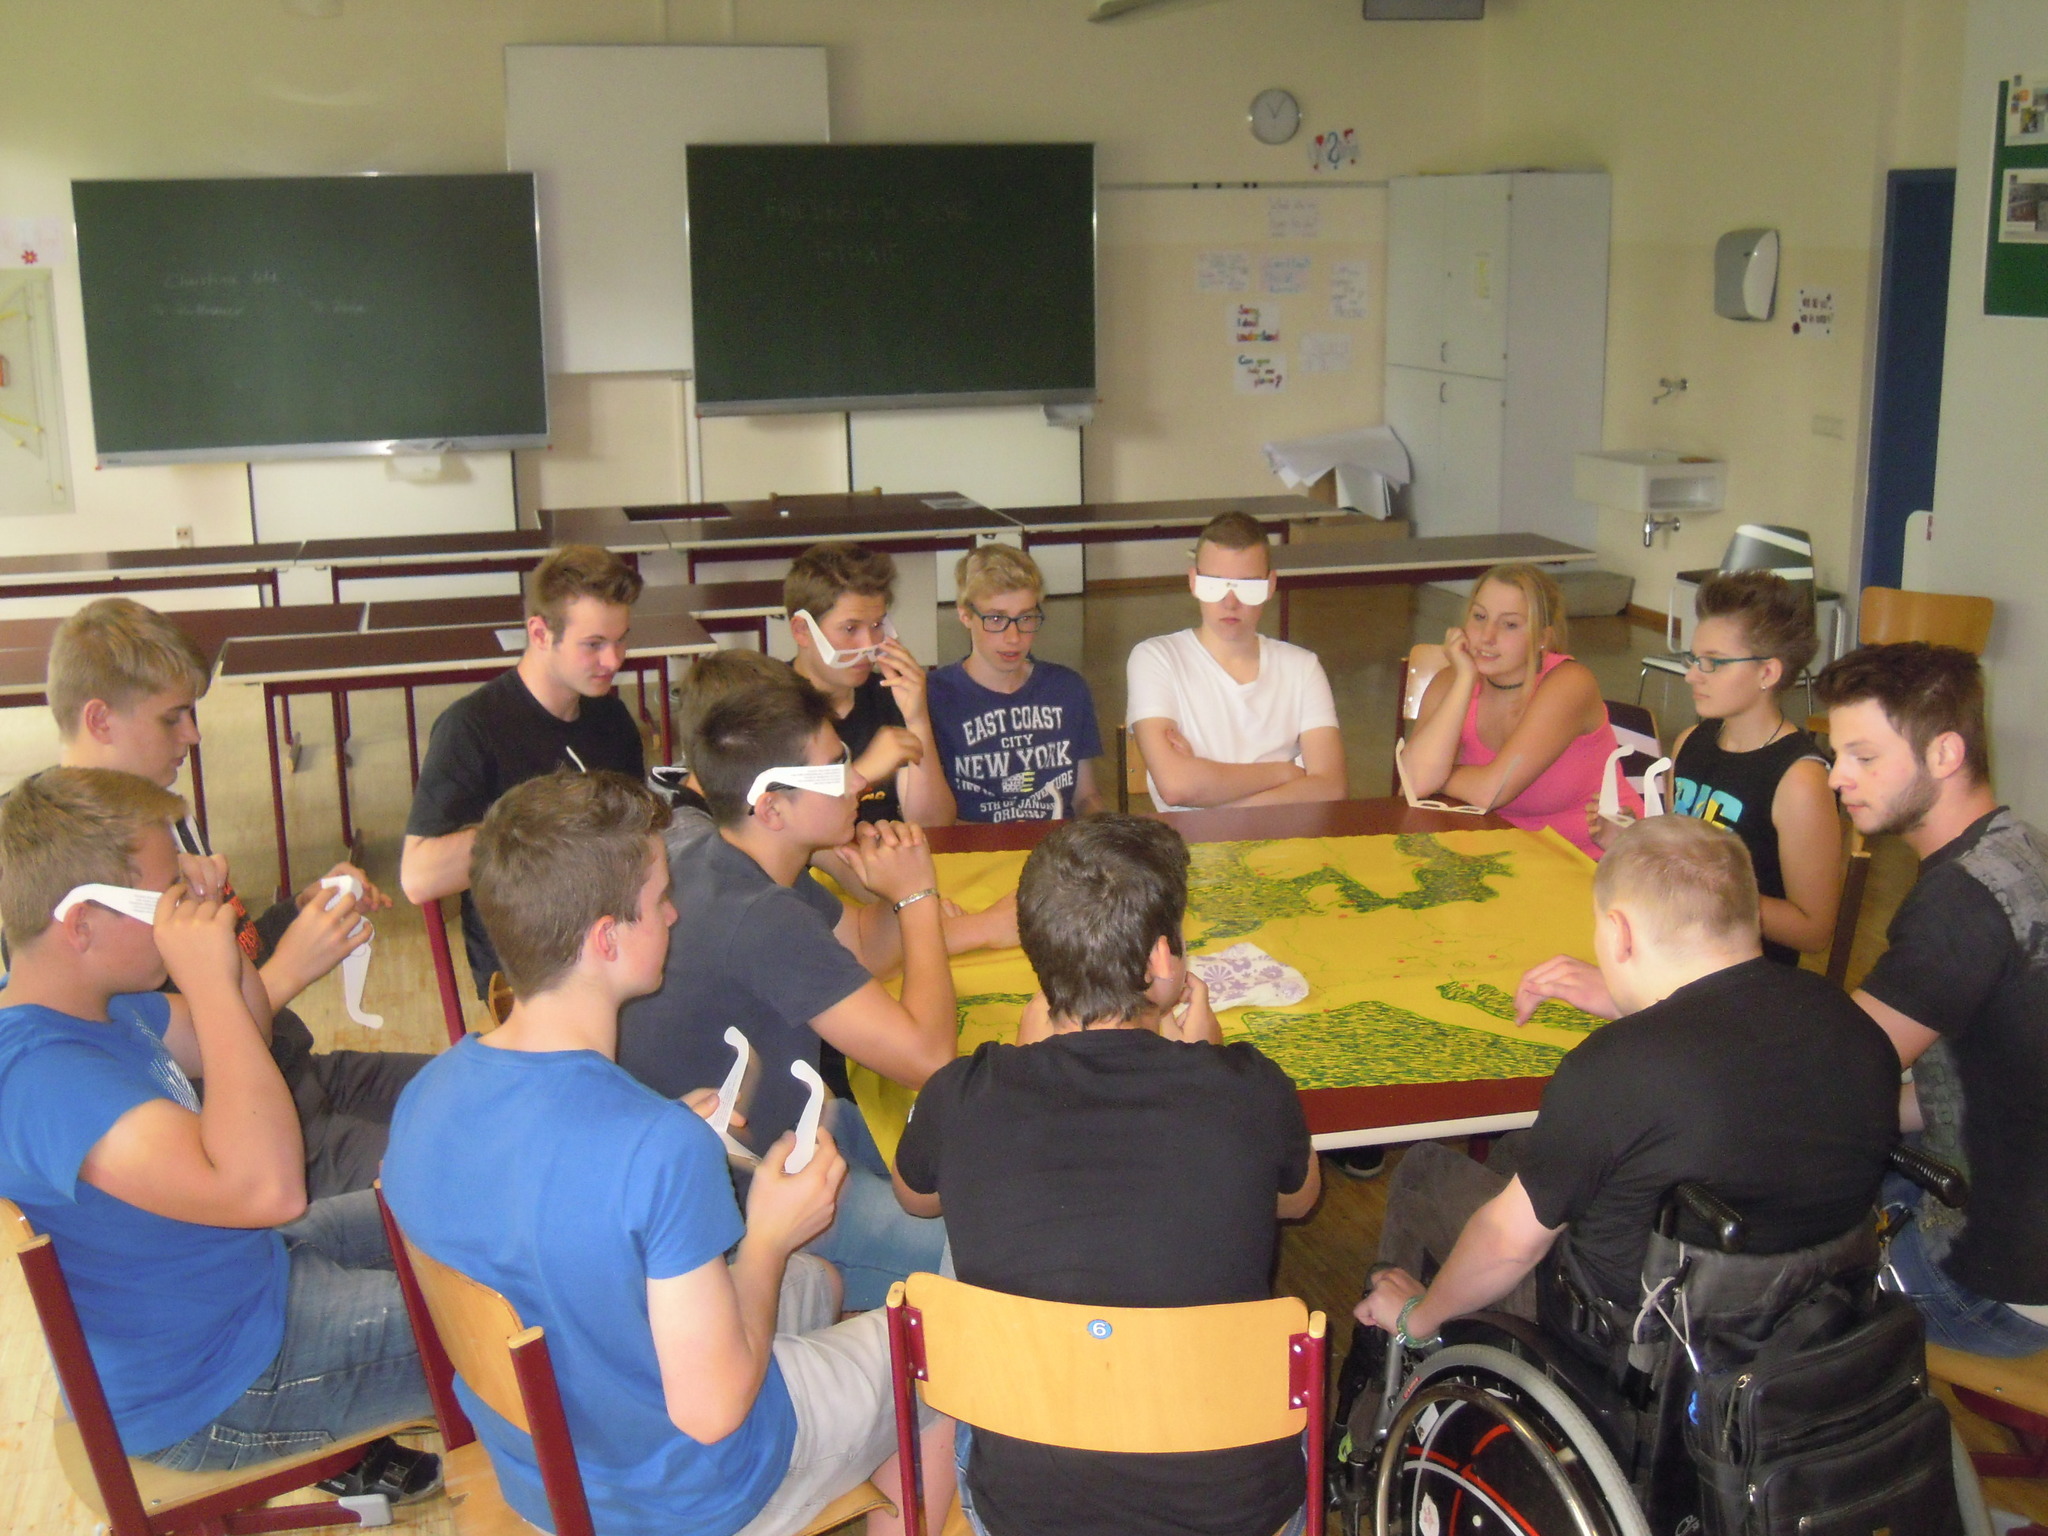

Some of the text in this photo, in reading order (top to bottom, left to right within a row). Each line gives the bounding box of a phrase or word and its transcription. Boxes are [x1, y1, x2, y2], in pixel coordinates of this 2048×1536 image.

[962, 705, 1063, 746] EAST COAST
[1001, 734, 1034, 749] CITY
[955, 741, 1072, 780] NEW YORK
[1092, 1322, 1107, 1337] 6
